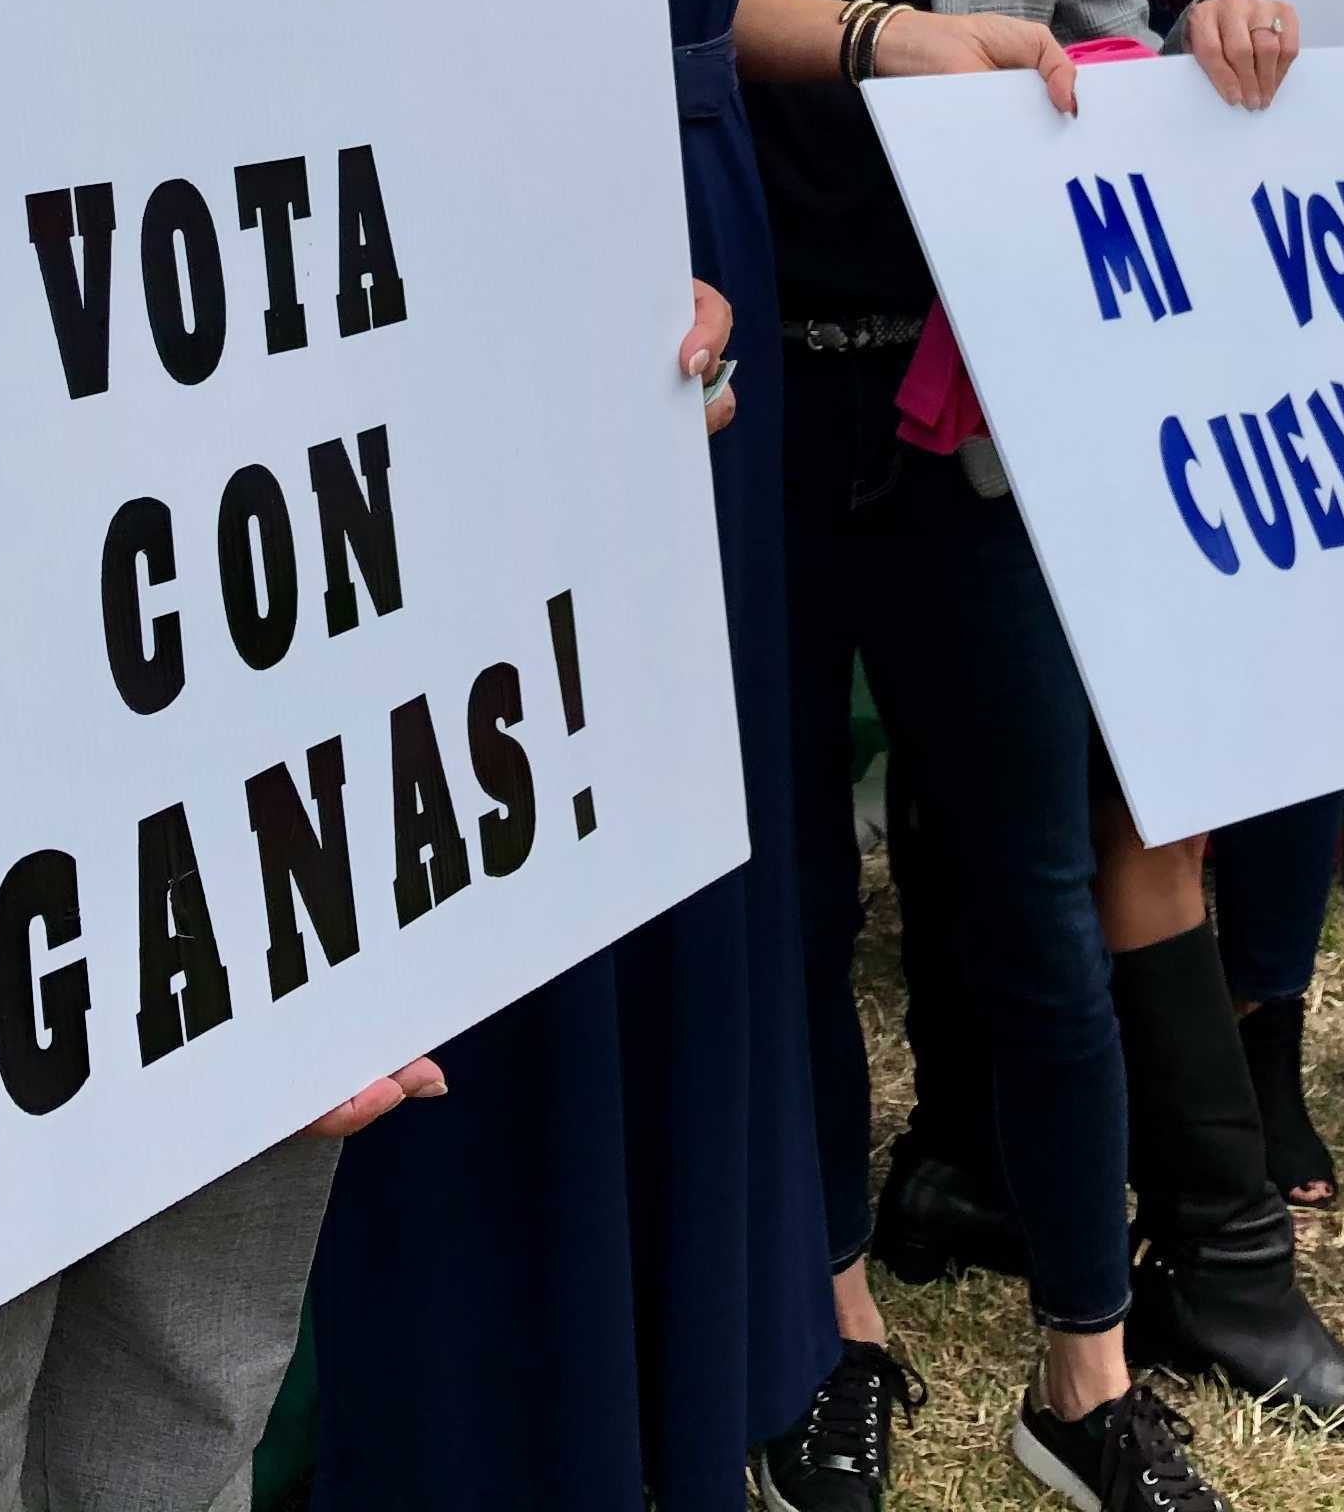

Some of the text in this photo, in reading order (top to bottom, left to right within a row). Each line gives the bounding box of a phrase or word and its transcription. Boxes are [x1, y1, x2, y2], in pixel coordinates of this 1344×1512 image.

[25, 144, 407, 400] VOTA
[1066, 173, 1193, 323] MI
[101, 423, 404, 715] CON
